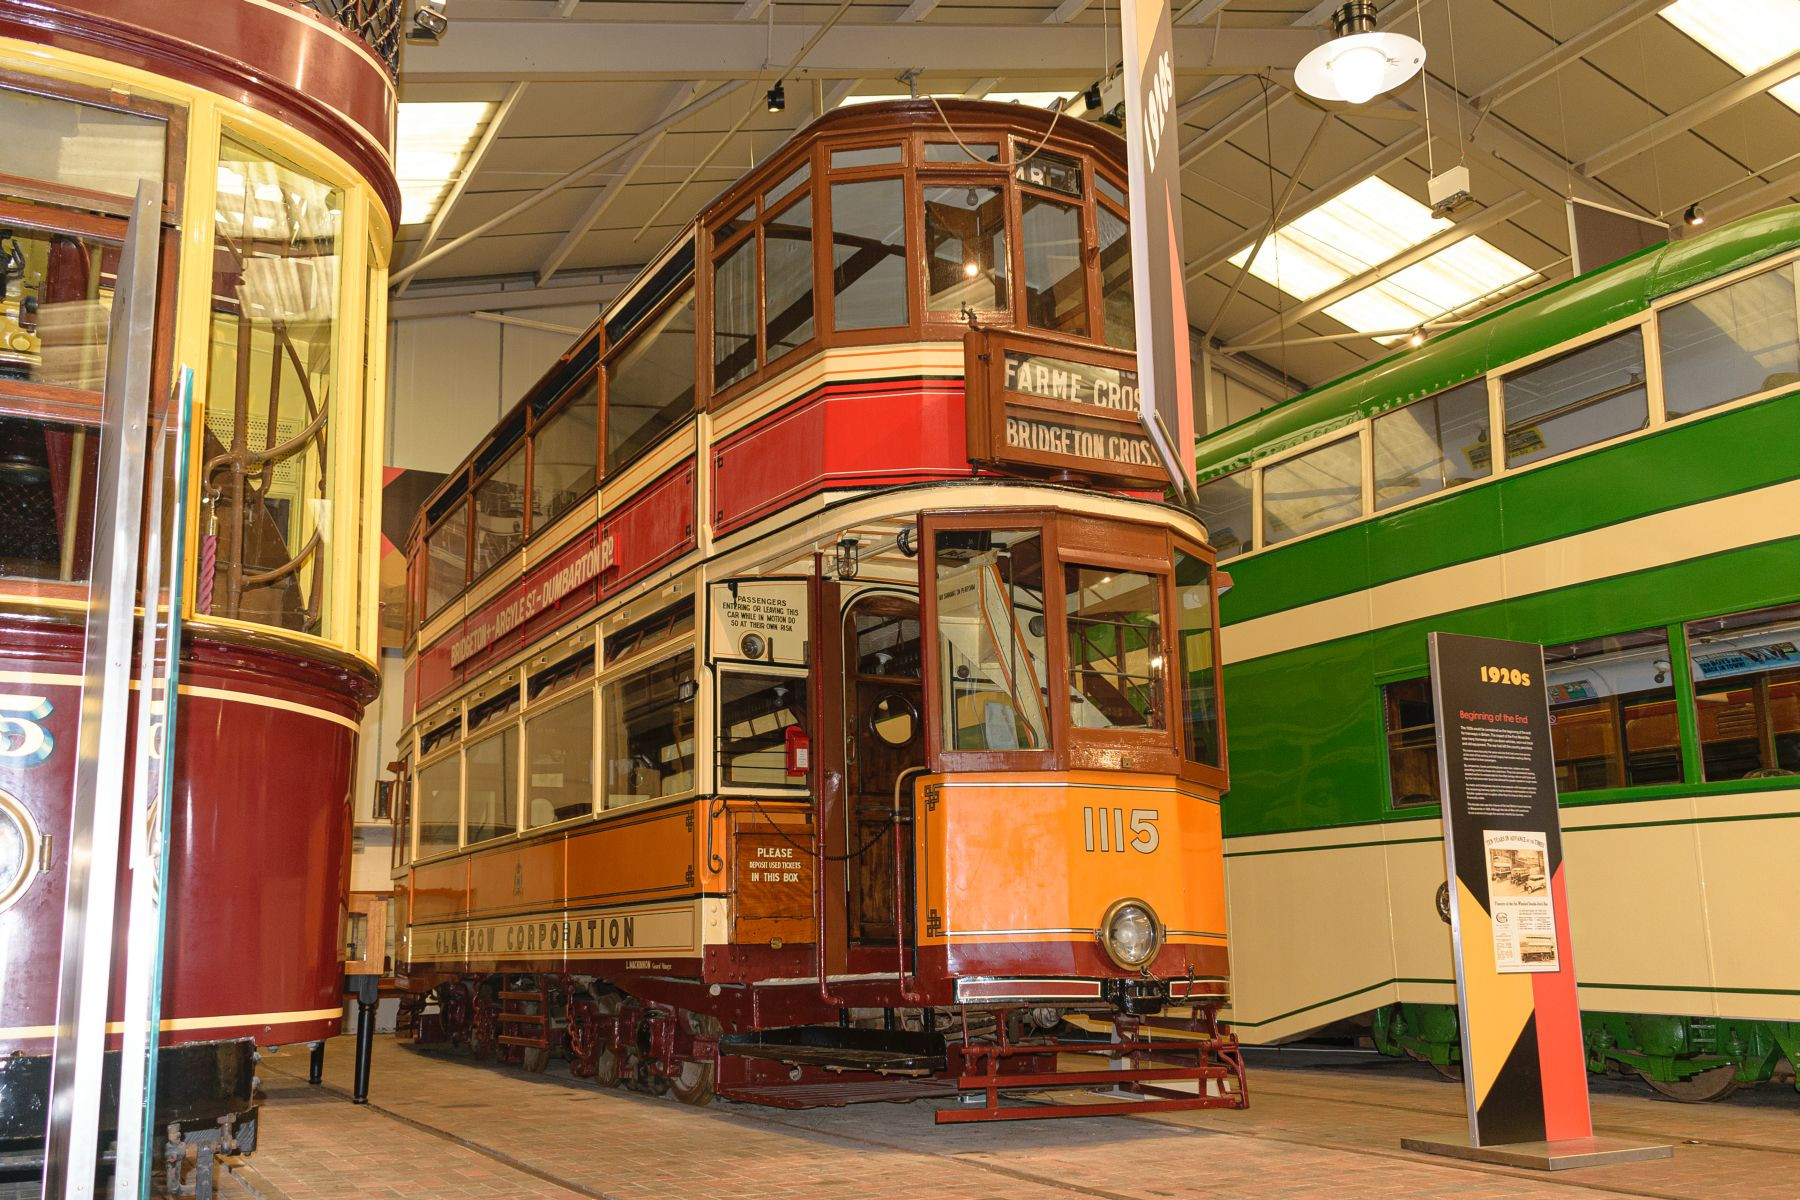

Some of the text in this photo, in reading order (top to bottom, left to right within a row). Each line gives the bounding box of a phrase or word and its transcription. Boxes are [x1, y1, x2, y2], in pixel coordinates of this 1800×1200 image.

[1004, 358, 1082, 403] FARME
[1006, 418, 1105, 460] BRIDGETON
[494, 596, 525, 640] ARGYLE
[542, 545, 601, 608] DUMBARTON
[737, 596, 787, 606] PASSENGERS
[763, 606, 784, 614] LEAVING
[727, 611, 739, 619] CAR
[741, 612, 757, 620] WHILE
[767, 615, 787, 623] MOTION
[750, 621, 765, 629] THEIR
[1480, 665, 1531, 687] 1920s
[1459, 710, 1528, 724] Beginning of the End
[1083, 806, 1160, 854] 1115
[757, 847, 793, 858] PLEASE
[749, 861, 801, 869] DEPOSIT USED TICKETS
[751, 872, 799, 883] IN THIS BOX
[436, 916, 635, 954] GLASGOW CORPORATION
